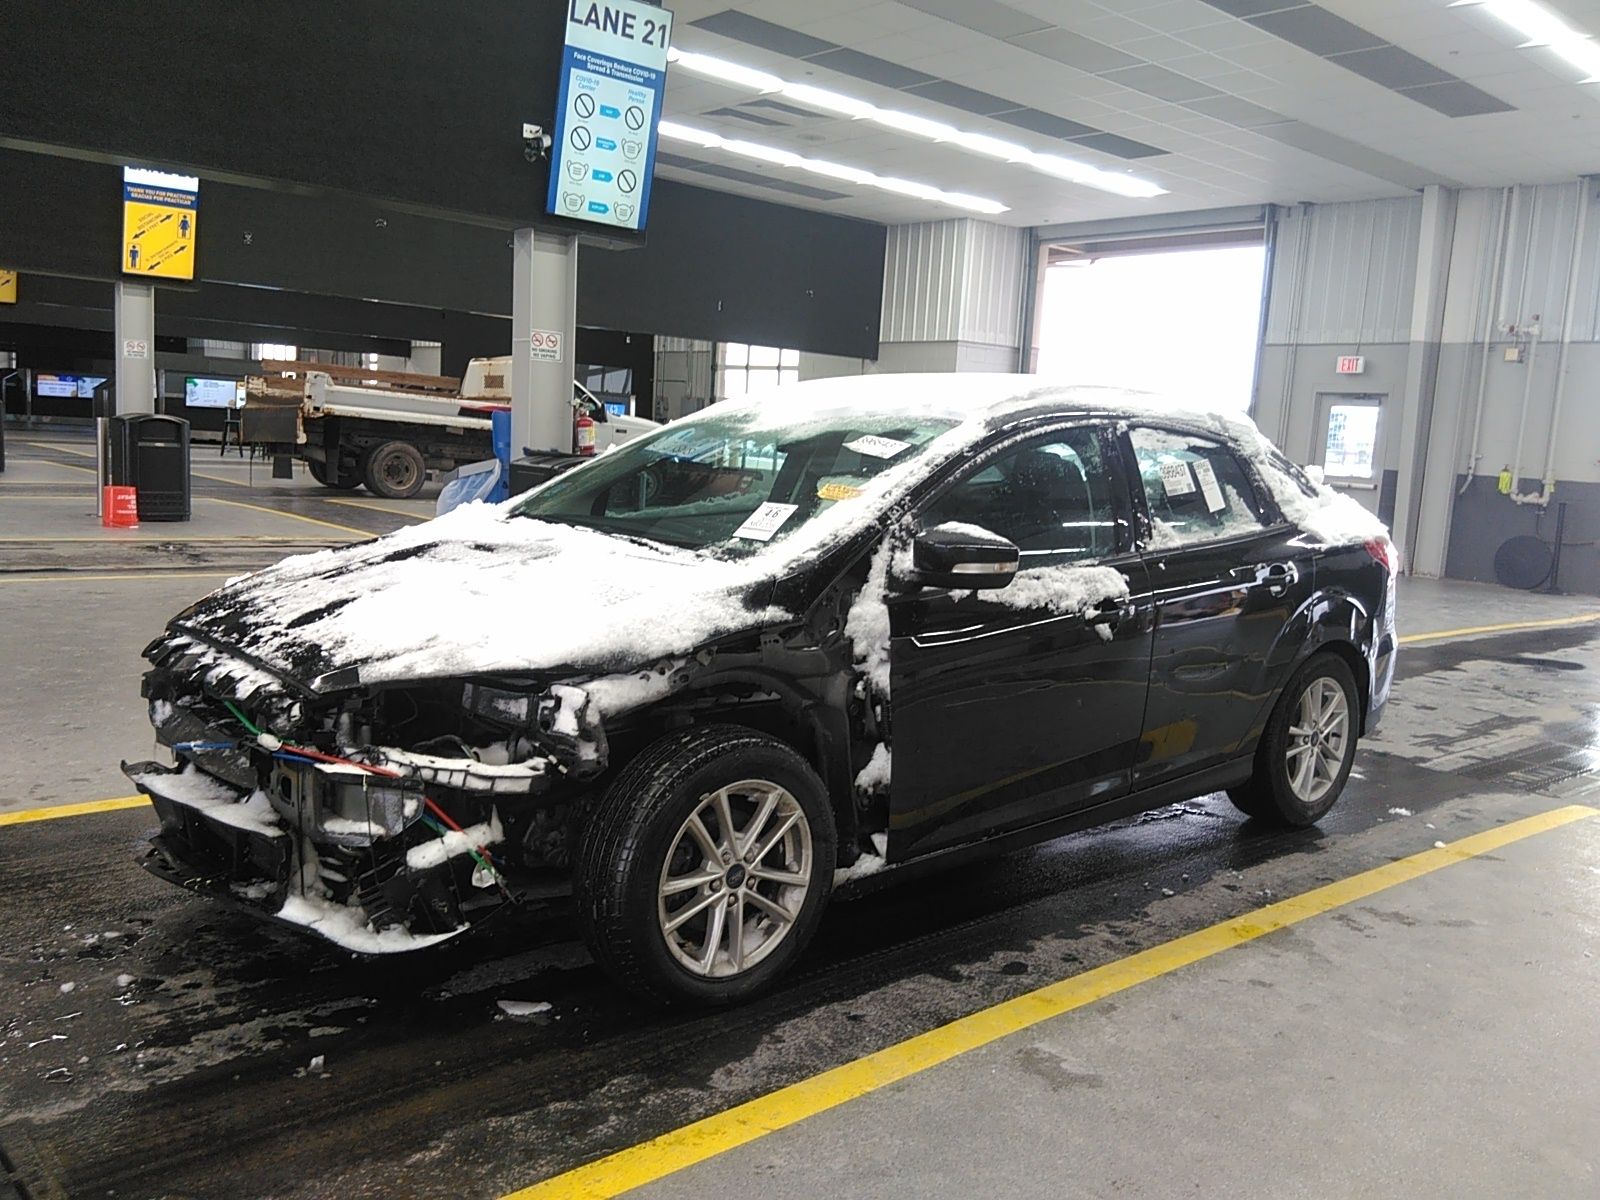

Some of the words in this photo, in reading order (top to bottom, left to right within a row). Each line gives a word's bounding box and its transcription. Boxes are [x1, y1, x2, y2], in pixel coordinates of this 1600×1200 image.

[569, 0, 637, 40] LANE
[641, 19, 667, 49] 21
[573, 52, 586, 61] Face
[587, 56, 613, 69] Coverings
[613, 63, 632, 74] Reduce
[632, 68, 656, 80] COVID-19
[587, 62, 607, 73] Spread
[611, 69, 644, 83] Transmission
[575, 75, 600, 86] COVID-19
[127, 186, 144, 194] THANK
[1341, 357, 1360, 372] EXIT
